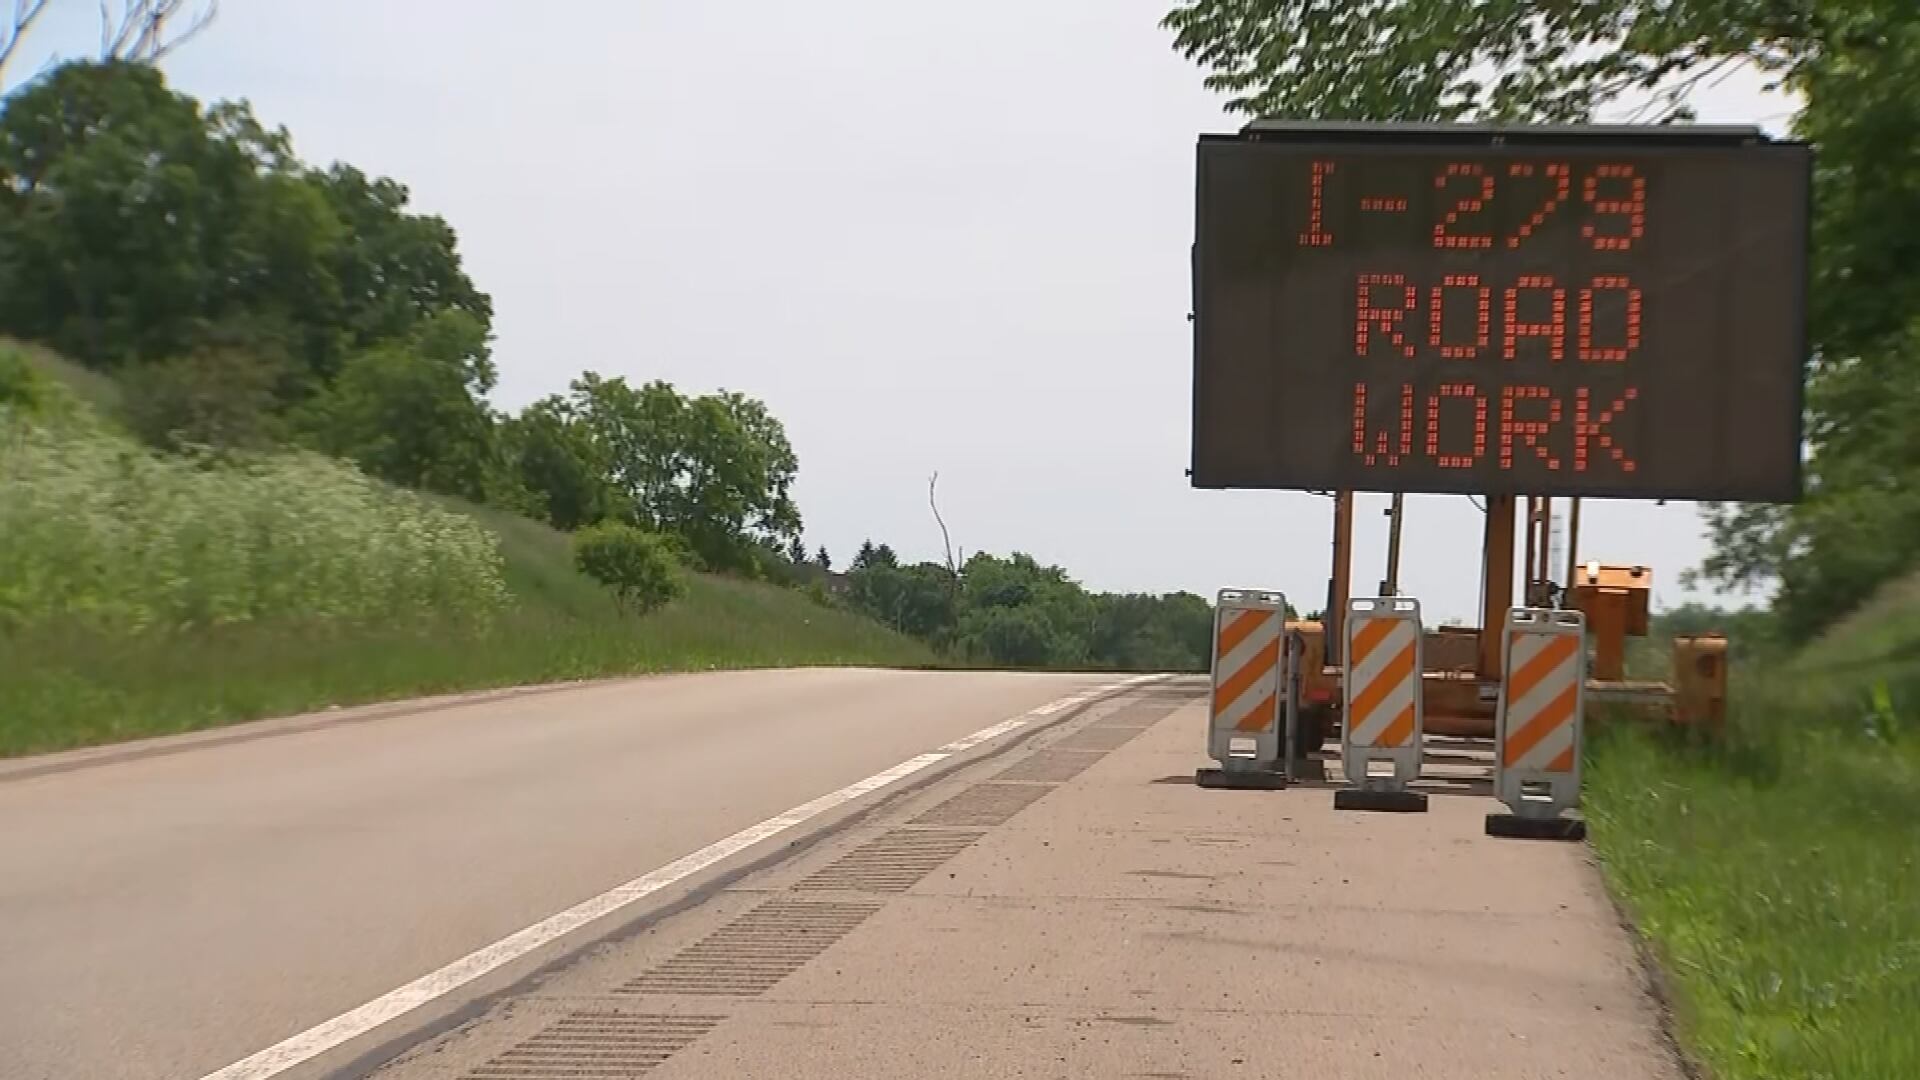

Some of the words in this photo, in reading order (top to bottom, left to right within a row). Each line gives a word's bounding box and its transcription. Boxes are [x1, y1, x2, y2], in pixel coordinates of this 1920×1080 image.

[1300, 162, 1646, 250] I-279
[1356, 275, 1642, 360] ROAD
[1353, 383, 1637, 470] WORK
